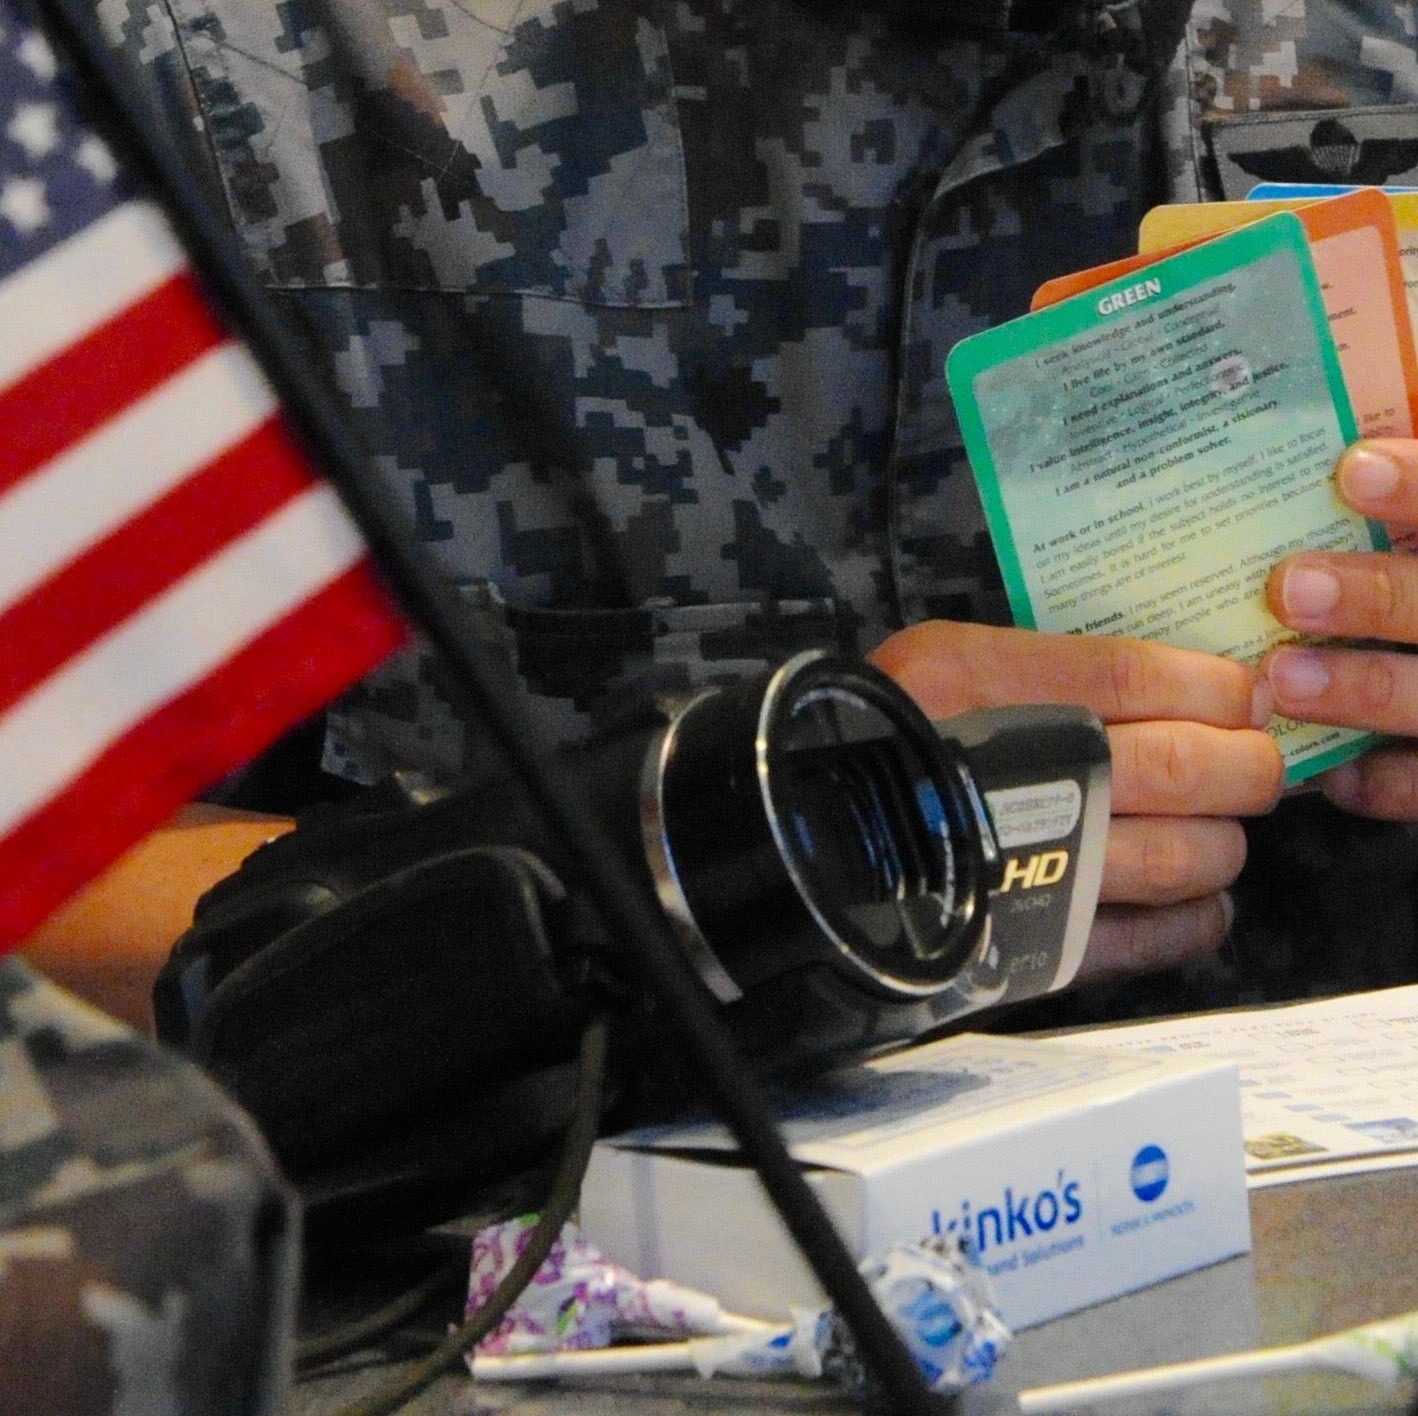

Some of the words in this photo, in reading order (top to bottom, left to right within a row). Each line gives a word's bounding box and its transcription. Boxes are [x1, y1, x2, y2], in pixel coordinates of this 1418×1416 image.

[1097, 279, 1162, 316] GREEN
[1071, 327, 1131, 354] knowledge
[1134, 314, 1154, 329] and
[1070, 405, 1098, 423] need
[1100, 380, 1169, 410] explanations
[1170, 366, 1192, 381] and
[1193, 347, 1243, 371] answers.
[1092, 367, 1110, 379] life
[1037, 454, 1067, 470] value
[1229, 376, 1249, 390] and
[1031, 541, 1046, 553] At
[1049, 529, 1077, 546] work
[1078, 524, 1092, 535] or
[1092, 520, 1104, 528] in
[1157, 487, 1180, 503] work
[1182, 477, 1206, 493] best
[1206, 472, 1220, 482] by
[1266, 445, 1285, 457] like
[1298, 429, 1327, 444] focus
[1062, 481, 1081, 494] am
[1093, 459, 1131, 481] natural
[1116, 473, 1136, 488] and
[1149, 453, 1194, 476] problem
[1035, 558, 1051, 569] on
[1054, 551, 1071, 561] my
[1073, 539, 1102, 554] ideas
[1104, 525, 1127, 542] until
[1130, 519, 1148, 530] my
[1148, 507, 1181, 523] desire
[1182, 498, 1198, 509] for
[1201, 468, 1273, 500] understanding
[1048, 569, 1065, 581] am
[1069, 557, 1099, 572] easily
[1102, 539, 1134, 559] bored
[1148, 529, 1166, 540] the
[1170, 510, 1206, 530] subject
[1208, 500, 1236, 514] holds
[1240, 490, 1255, 502] no
[1257, 472, 1297, 495] interest
[1299, 469, 1311, 477] to
[1132, 546, 1158, 563] hard
[1160, 542, 1175, 552] for
[1179, 531, 1197, 543] me
[1200, 527, 1212, 535] to
[1216, 517, 1230, 529] set
[1235, 500, 1279, 523] priorities
[1281, 482, 1323, 502] because
[1134, 597, 1158, 611] may
[1159, 585, 1187, 602] seem
[1238, 543, 1287, 569] Although
[1286, 536, 1305, 548] my
[1305, 518, 1351, 540] thoughts
[1047, 596, 1077, 612] many
[1078, 583, 1113, 601] things
[1113, 574, 1133, 588] are
[1134, 568, 1146, 579] of
[1174, 609, 1212, 630] people
[1216, 599, 1239, 611] who
[1242, 587, 1261, 600] are
[1186, 595, 1203, 607] am
[1204, 579, 1241, 598] uneasy
[1244, 568, 1267, 583] with
[999, 849, 1069, 893] HD
